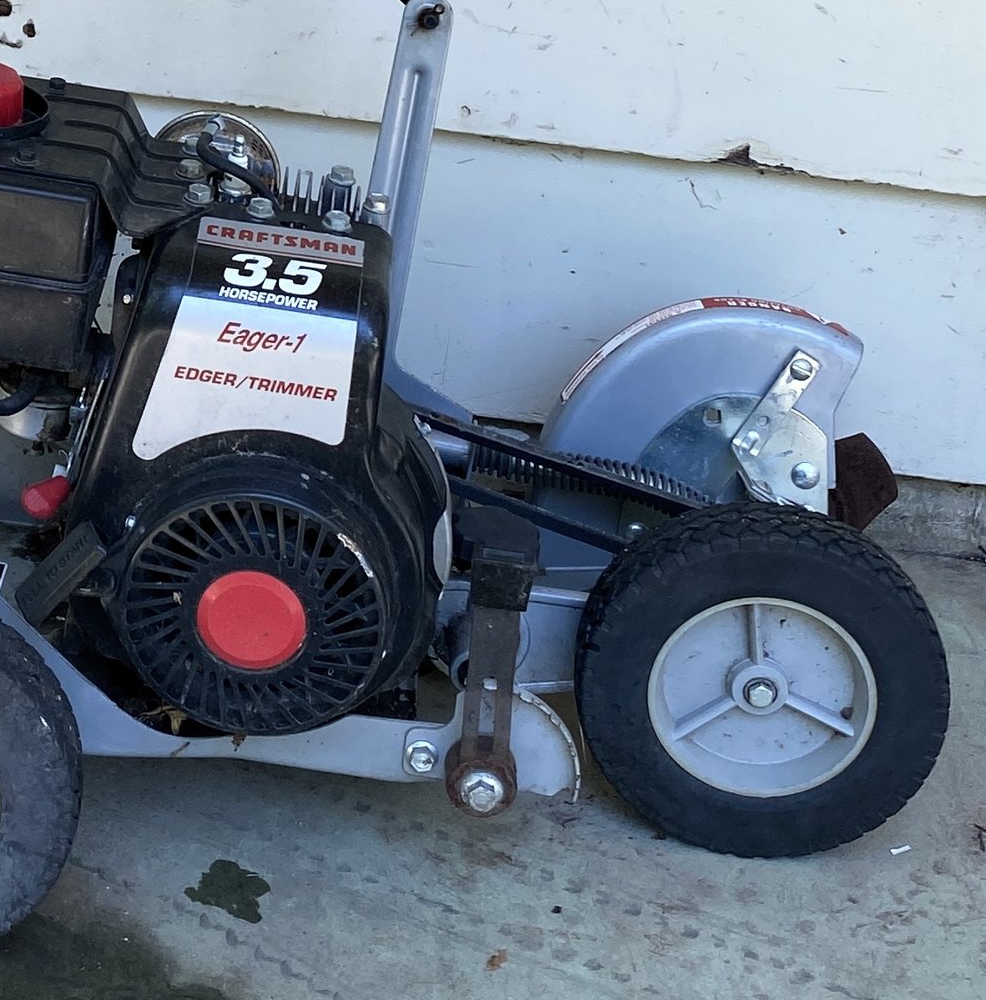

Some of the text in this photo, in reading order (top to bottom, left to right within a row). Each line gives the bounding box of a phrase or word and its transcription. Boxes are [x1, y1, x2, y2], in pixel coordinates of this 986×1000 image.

[206, 224, 357, 256] CRAFTSMAN
[223, 253, 328, 295] 3.5
[219, 286, 318, 311] HORSEPOWER
[217, 321, 307, 353] Eager-1
[174, 365, 338, 401] EDGER/TRIMMER
